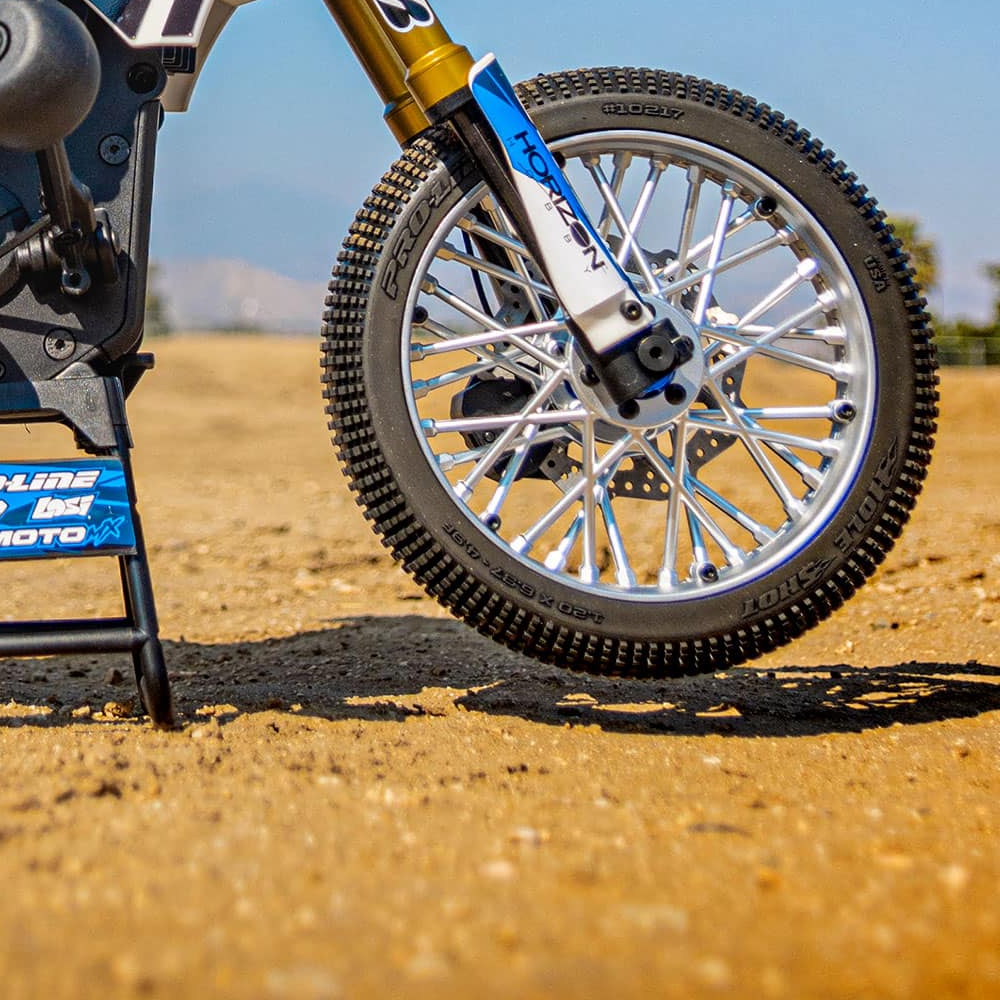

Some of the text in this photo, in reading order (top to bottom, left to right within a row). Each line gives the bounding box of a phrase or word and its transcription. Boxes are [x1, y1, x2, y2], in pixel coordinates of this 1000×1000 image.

[603, 101, 685, 120] #10217
[514, 130, 606, 271] HORIZON
[864, 255, 888, 293] USA
